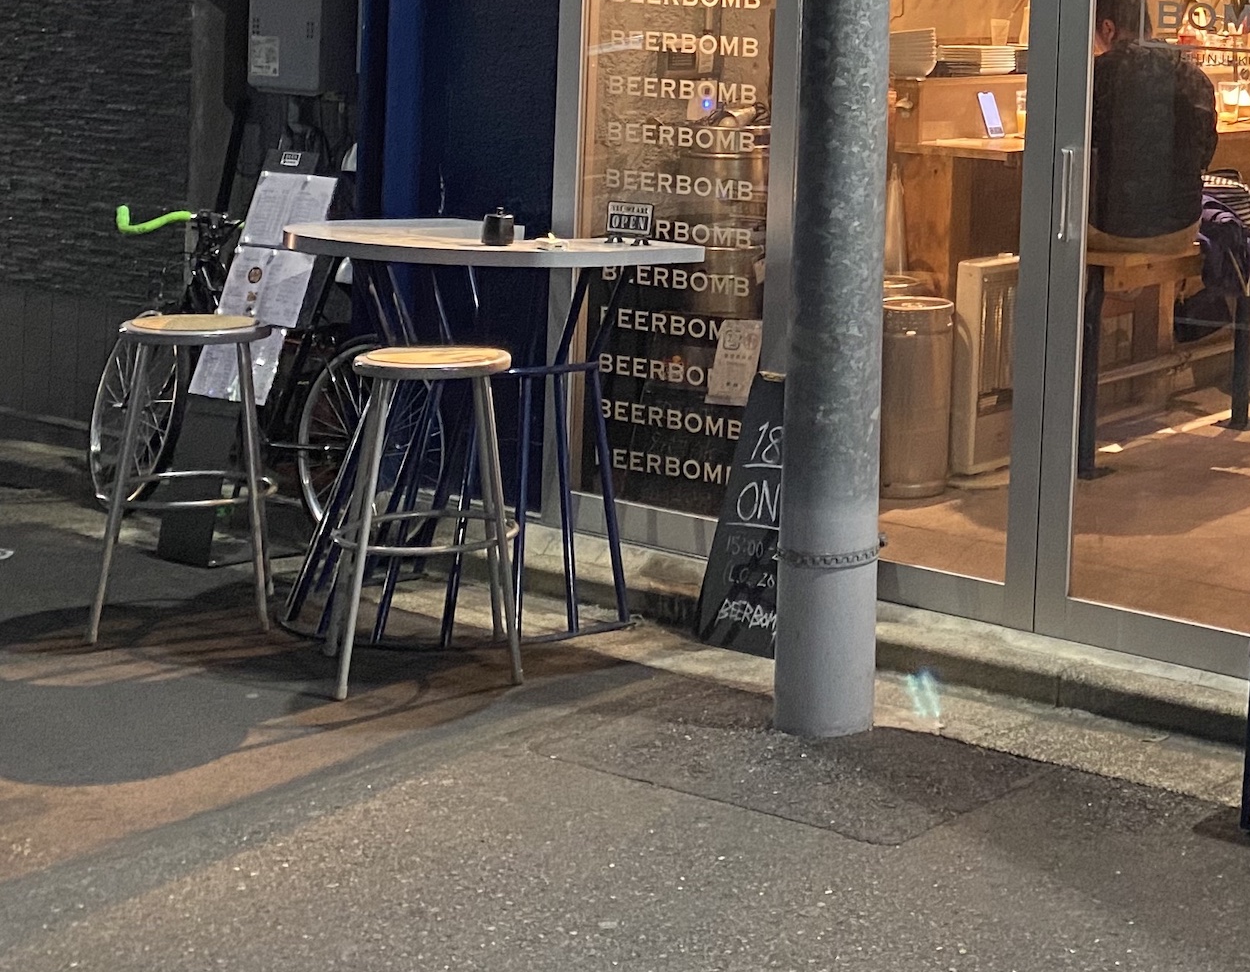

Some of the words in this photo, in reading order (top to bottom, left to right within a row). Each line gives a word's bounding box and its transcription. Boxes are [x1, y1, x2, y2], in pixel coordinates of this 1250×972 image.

[610, 29, 759, 57] BEERBOMB
[608, 76, 757, 104] BEERBOMB
[607, 121, 756, 152] BEERBOMB
[605, 168, 753, 201] BEERBOMB
[611, 215, 648, 230] OPEN
[602, 265, 750, 297] BERBOMB
[599, 353, 712, 387] BEERBO
[750, 421, 782, 463] 18
[594, 446, 732, 486] EERBOM
[714, 598, 778, 632] BEERBOM
